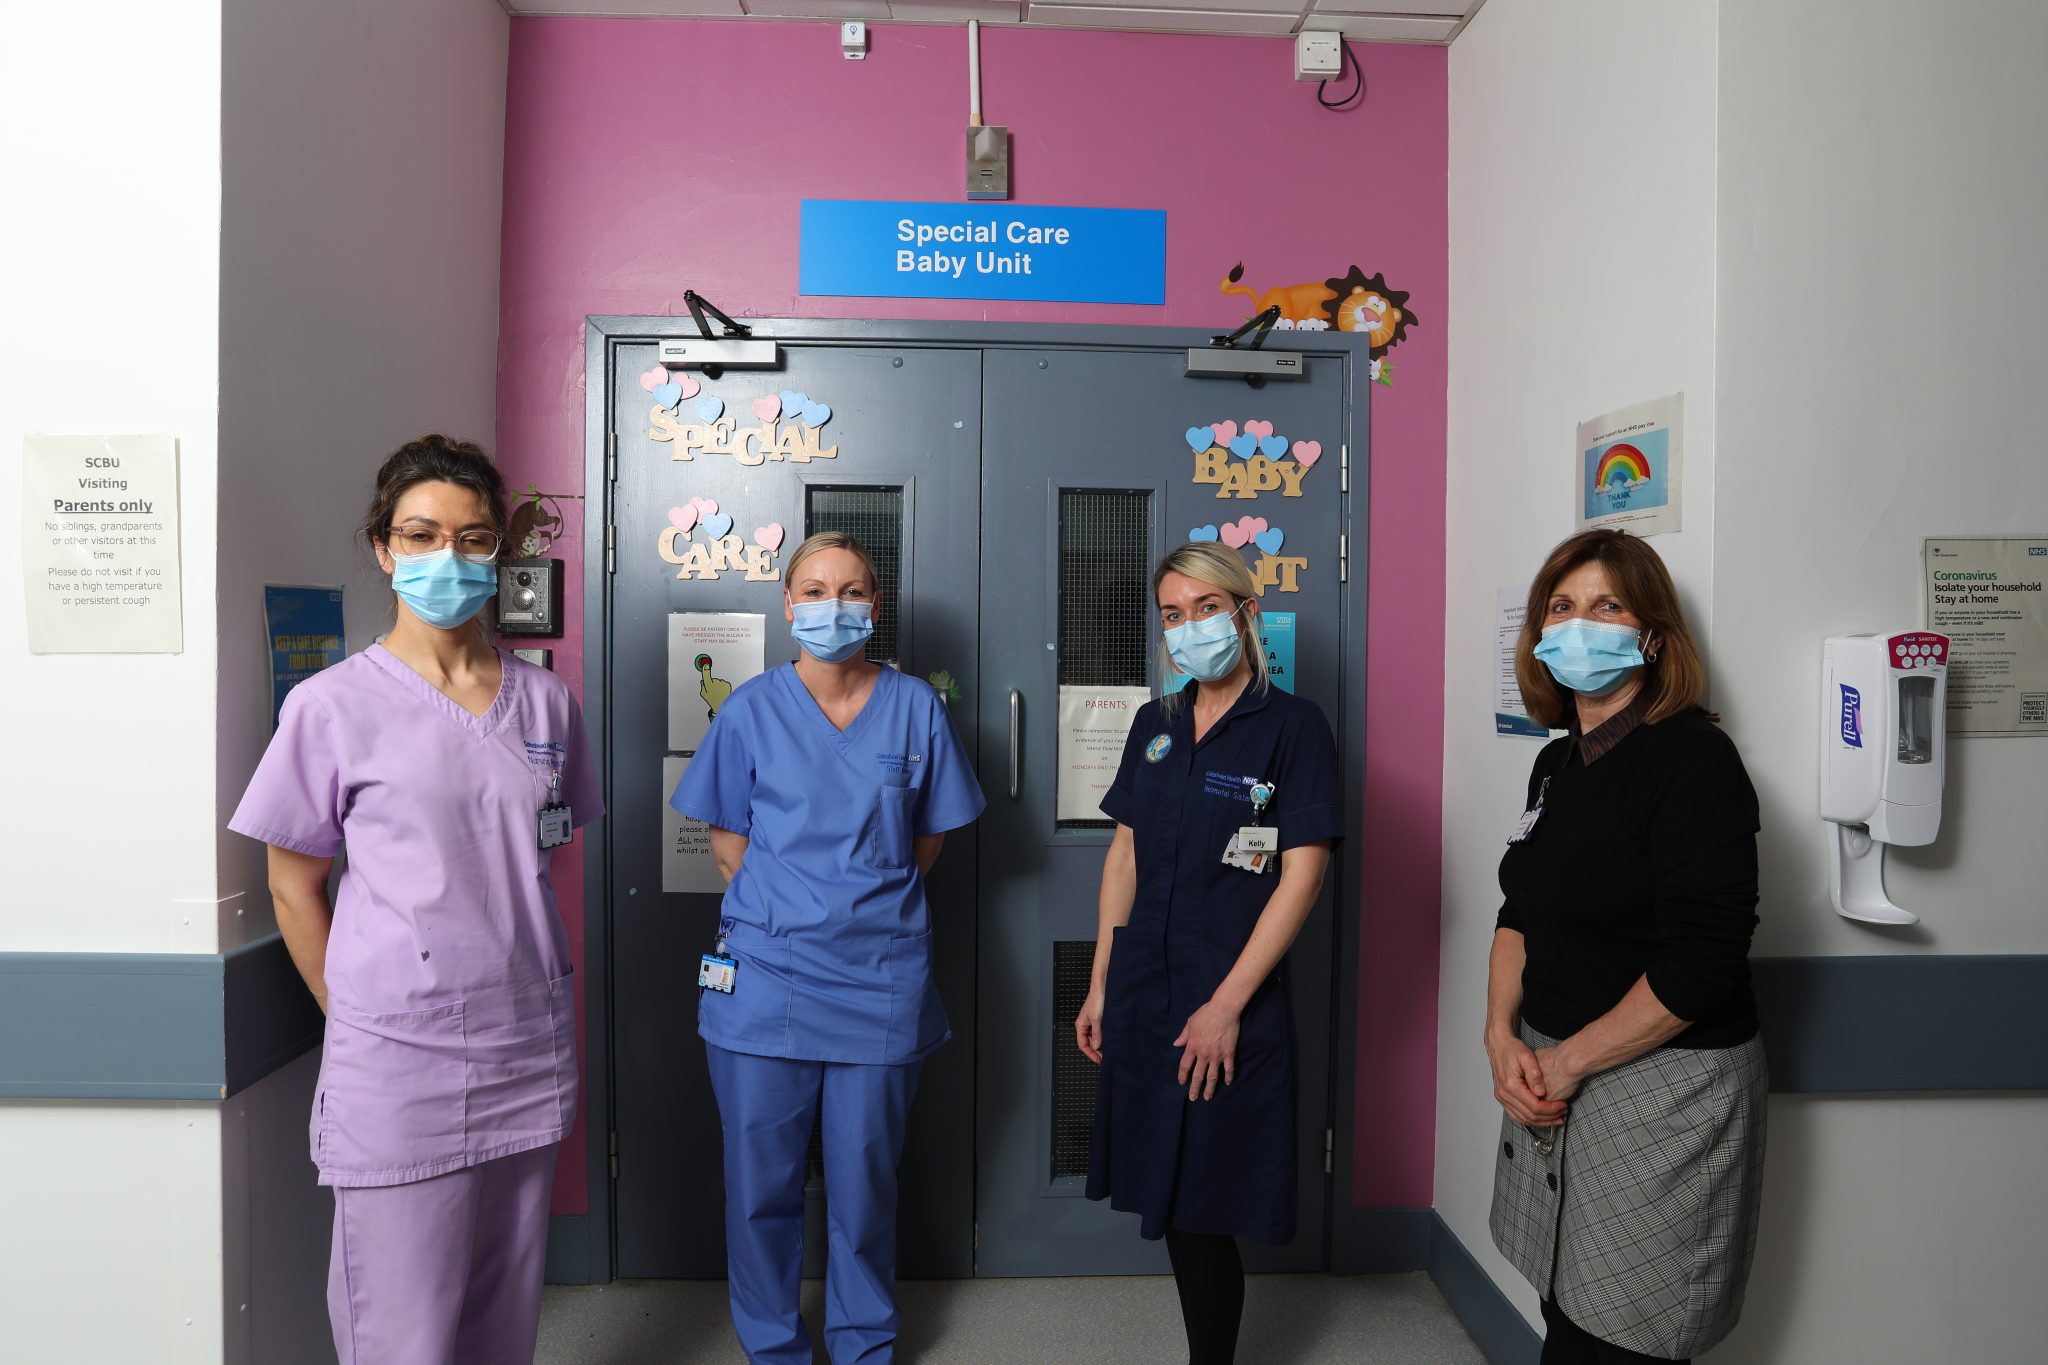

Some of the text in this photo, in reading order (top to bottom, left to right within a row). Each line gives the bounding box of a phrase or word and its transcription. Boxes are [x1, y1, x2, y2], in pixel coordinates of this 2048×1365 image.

[897, 219, 1070, 247] Special Care
[897, 250, 1032, 279] Baby Unit
[649, 404, 838, 466] SPECIAL
[85, 457, 120, 469] SCBU
[1192, 447, 1314, 499] BABY
[78, 477, 128, 490] Visiting
[1608, 490, 1631, 502] THANK
[54, 499, 153, 515] Parents only
[1612, 500, 1626, 510] YOU
[45, 522, 163, 532] No siblings, grandparents
[52, 536, 157, 545] or other visitors at this
[93, 550, 114, 560] time
[658, 526, 781, 582] CARE
[48, 567, 161, 578] Please do not visit if you
[1247, 551, 1308, 597] NIT
[1934, 570, 1998, 581] Coronavirus
[48, 581, 70, 590] have
[82, 581, 102, 592] high
[106, 582, 162, 592] temperature
[1934, 582, 2042, 594] Isolate your household
[74, 596, 120, 606] persistent
[122, 596, 150, 606] cough
[1935, 594, 1999, 605] Stay at home
[1269, 652, 1276, 660] A
[1268, 666, 1284, 674] REA
[1085, 700, 1127, 710] PARENTS
[1843, 691, 1858, 741] Purell
[1242, 776, 1258, 785] NHS
[1204, 785, 1230, 798] Neonatal
[680, 825, 702, 834] please
[677, 836, 692, 844] ALL
[1248, 840, 1266, 848] Kelly
[676, 846, 698, 854] whilst
